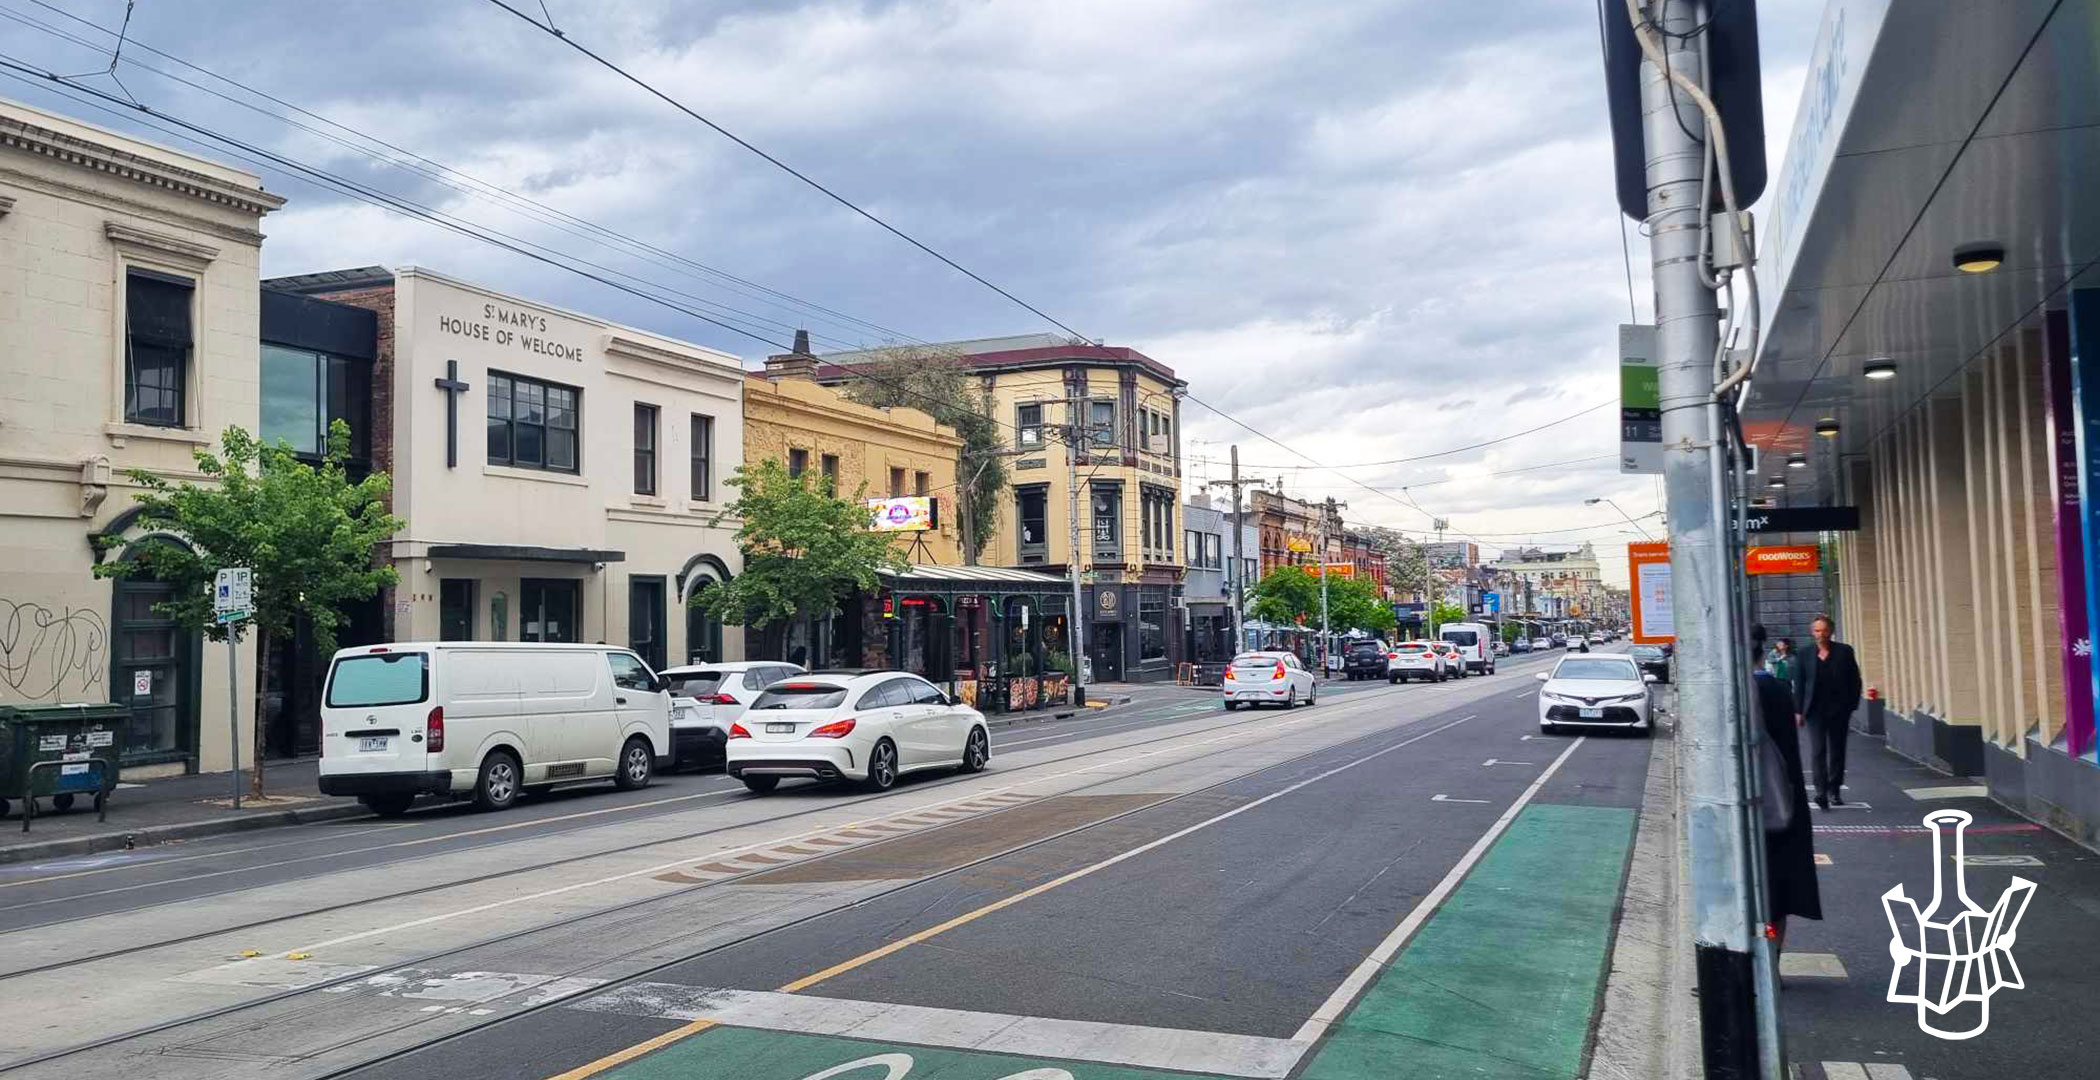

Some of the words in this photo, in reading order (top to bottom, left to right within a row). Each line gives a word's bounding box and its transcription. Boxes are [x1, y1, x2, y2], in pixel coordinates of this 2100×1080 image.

[499, 308, 546, 332] MARY'S
[440, 315, 489, 341] HOUSE
[496, 329, 513, 346] OF
[521, 334, 583, 362] WELCOME
[1625, 426, 1638, 437] 11
[220, 573, 227, 583] P
[237, 571, 248, 582] 1P
